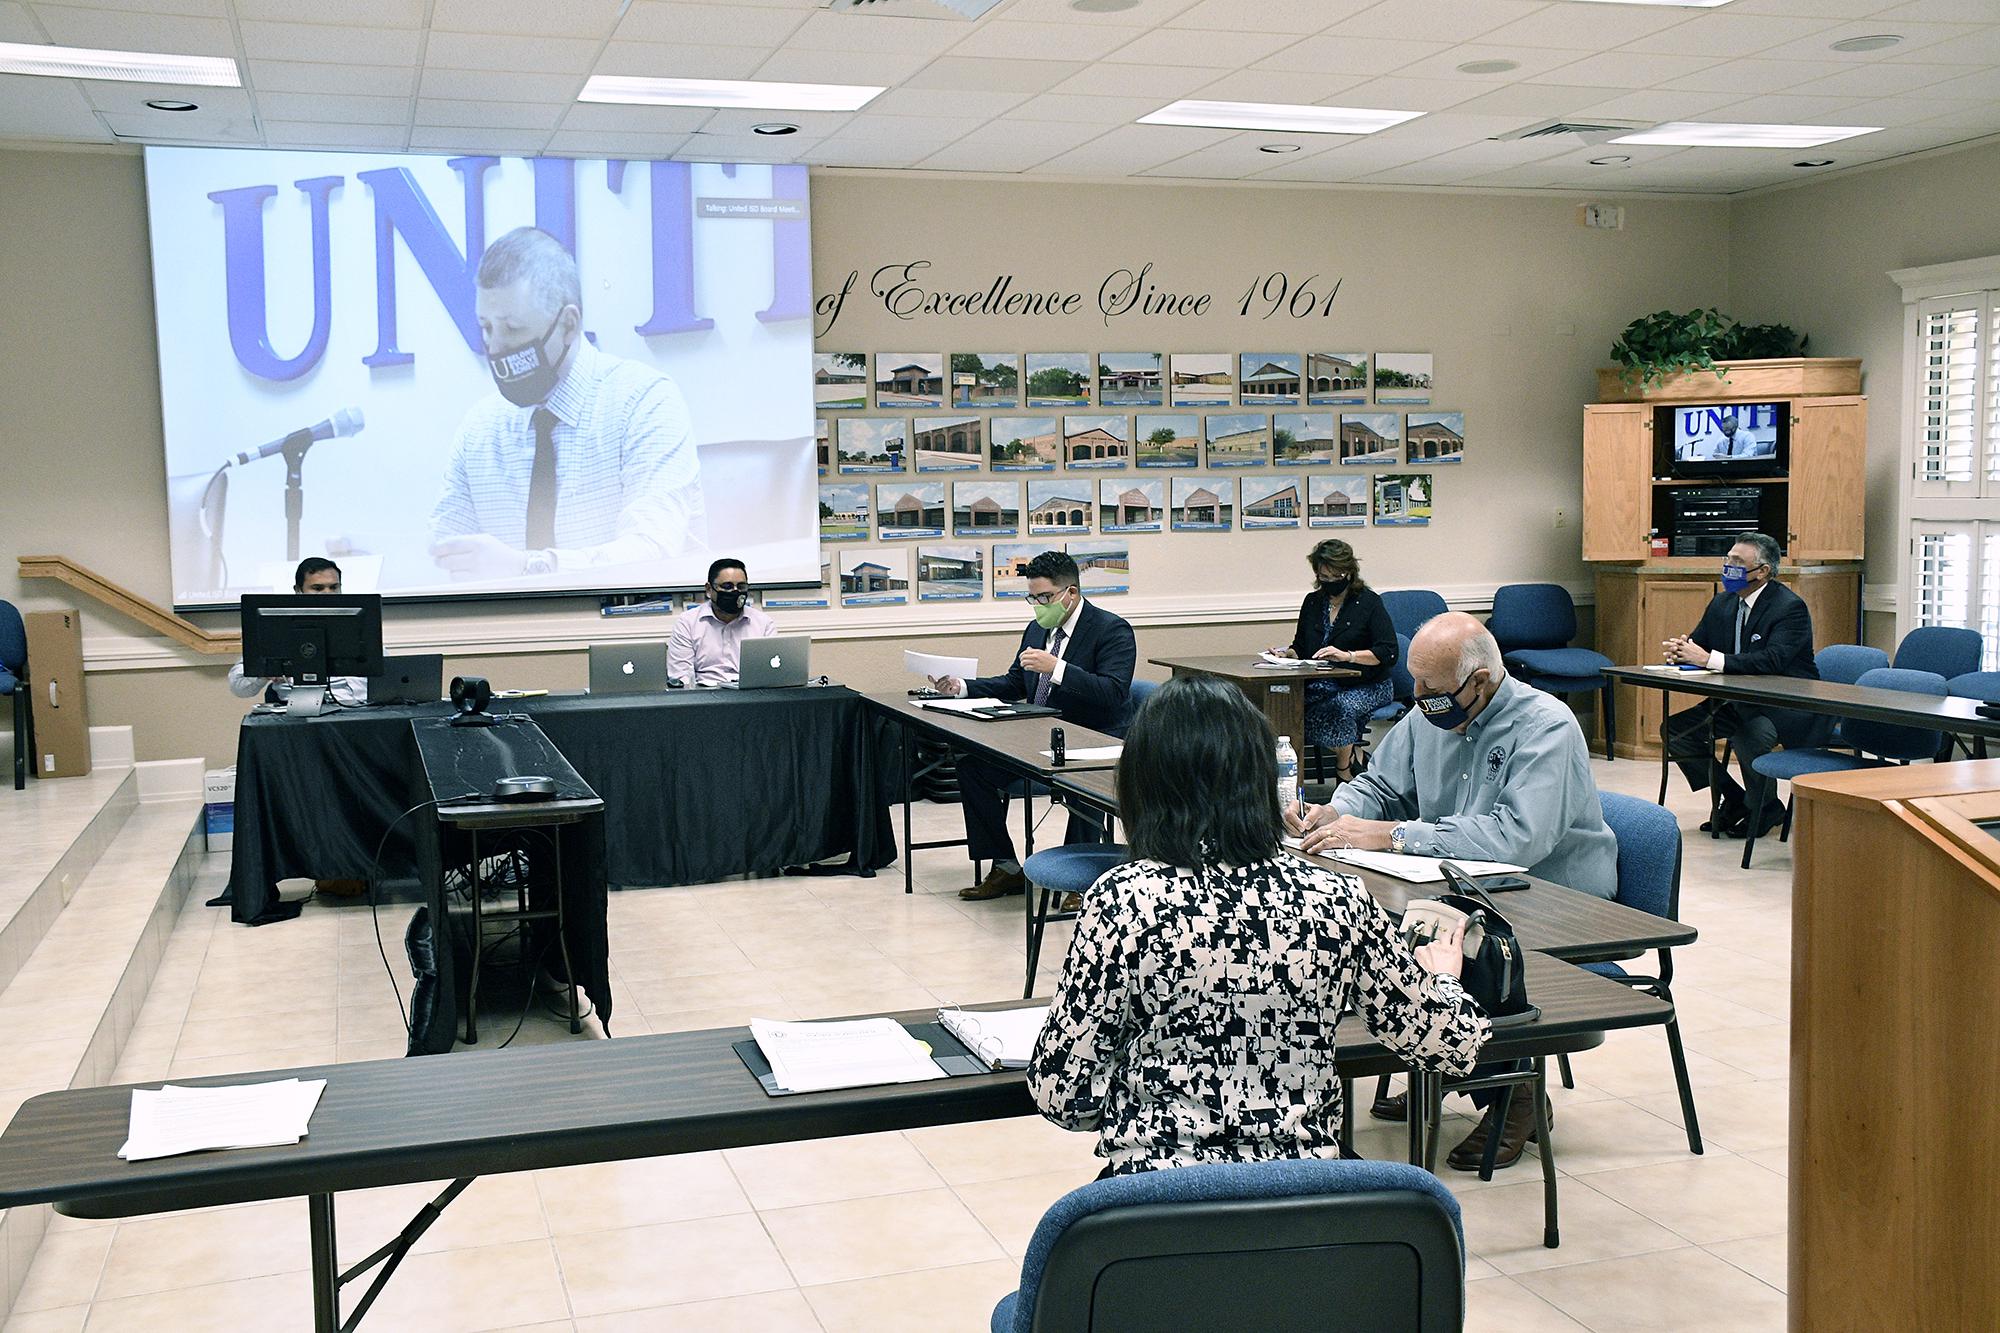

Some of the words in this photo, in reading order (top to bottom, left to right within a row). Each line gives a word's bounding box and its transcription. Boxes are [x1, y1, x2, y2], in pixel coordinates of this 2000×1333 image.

[207, 156, 809, 382] UNIT
[815, 270, 859, 340] of
[870, 260, 1082, 320] Excellence
[1098, 262, 1211, 328] Since
[1238, 271, 1343, 320] 1961
